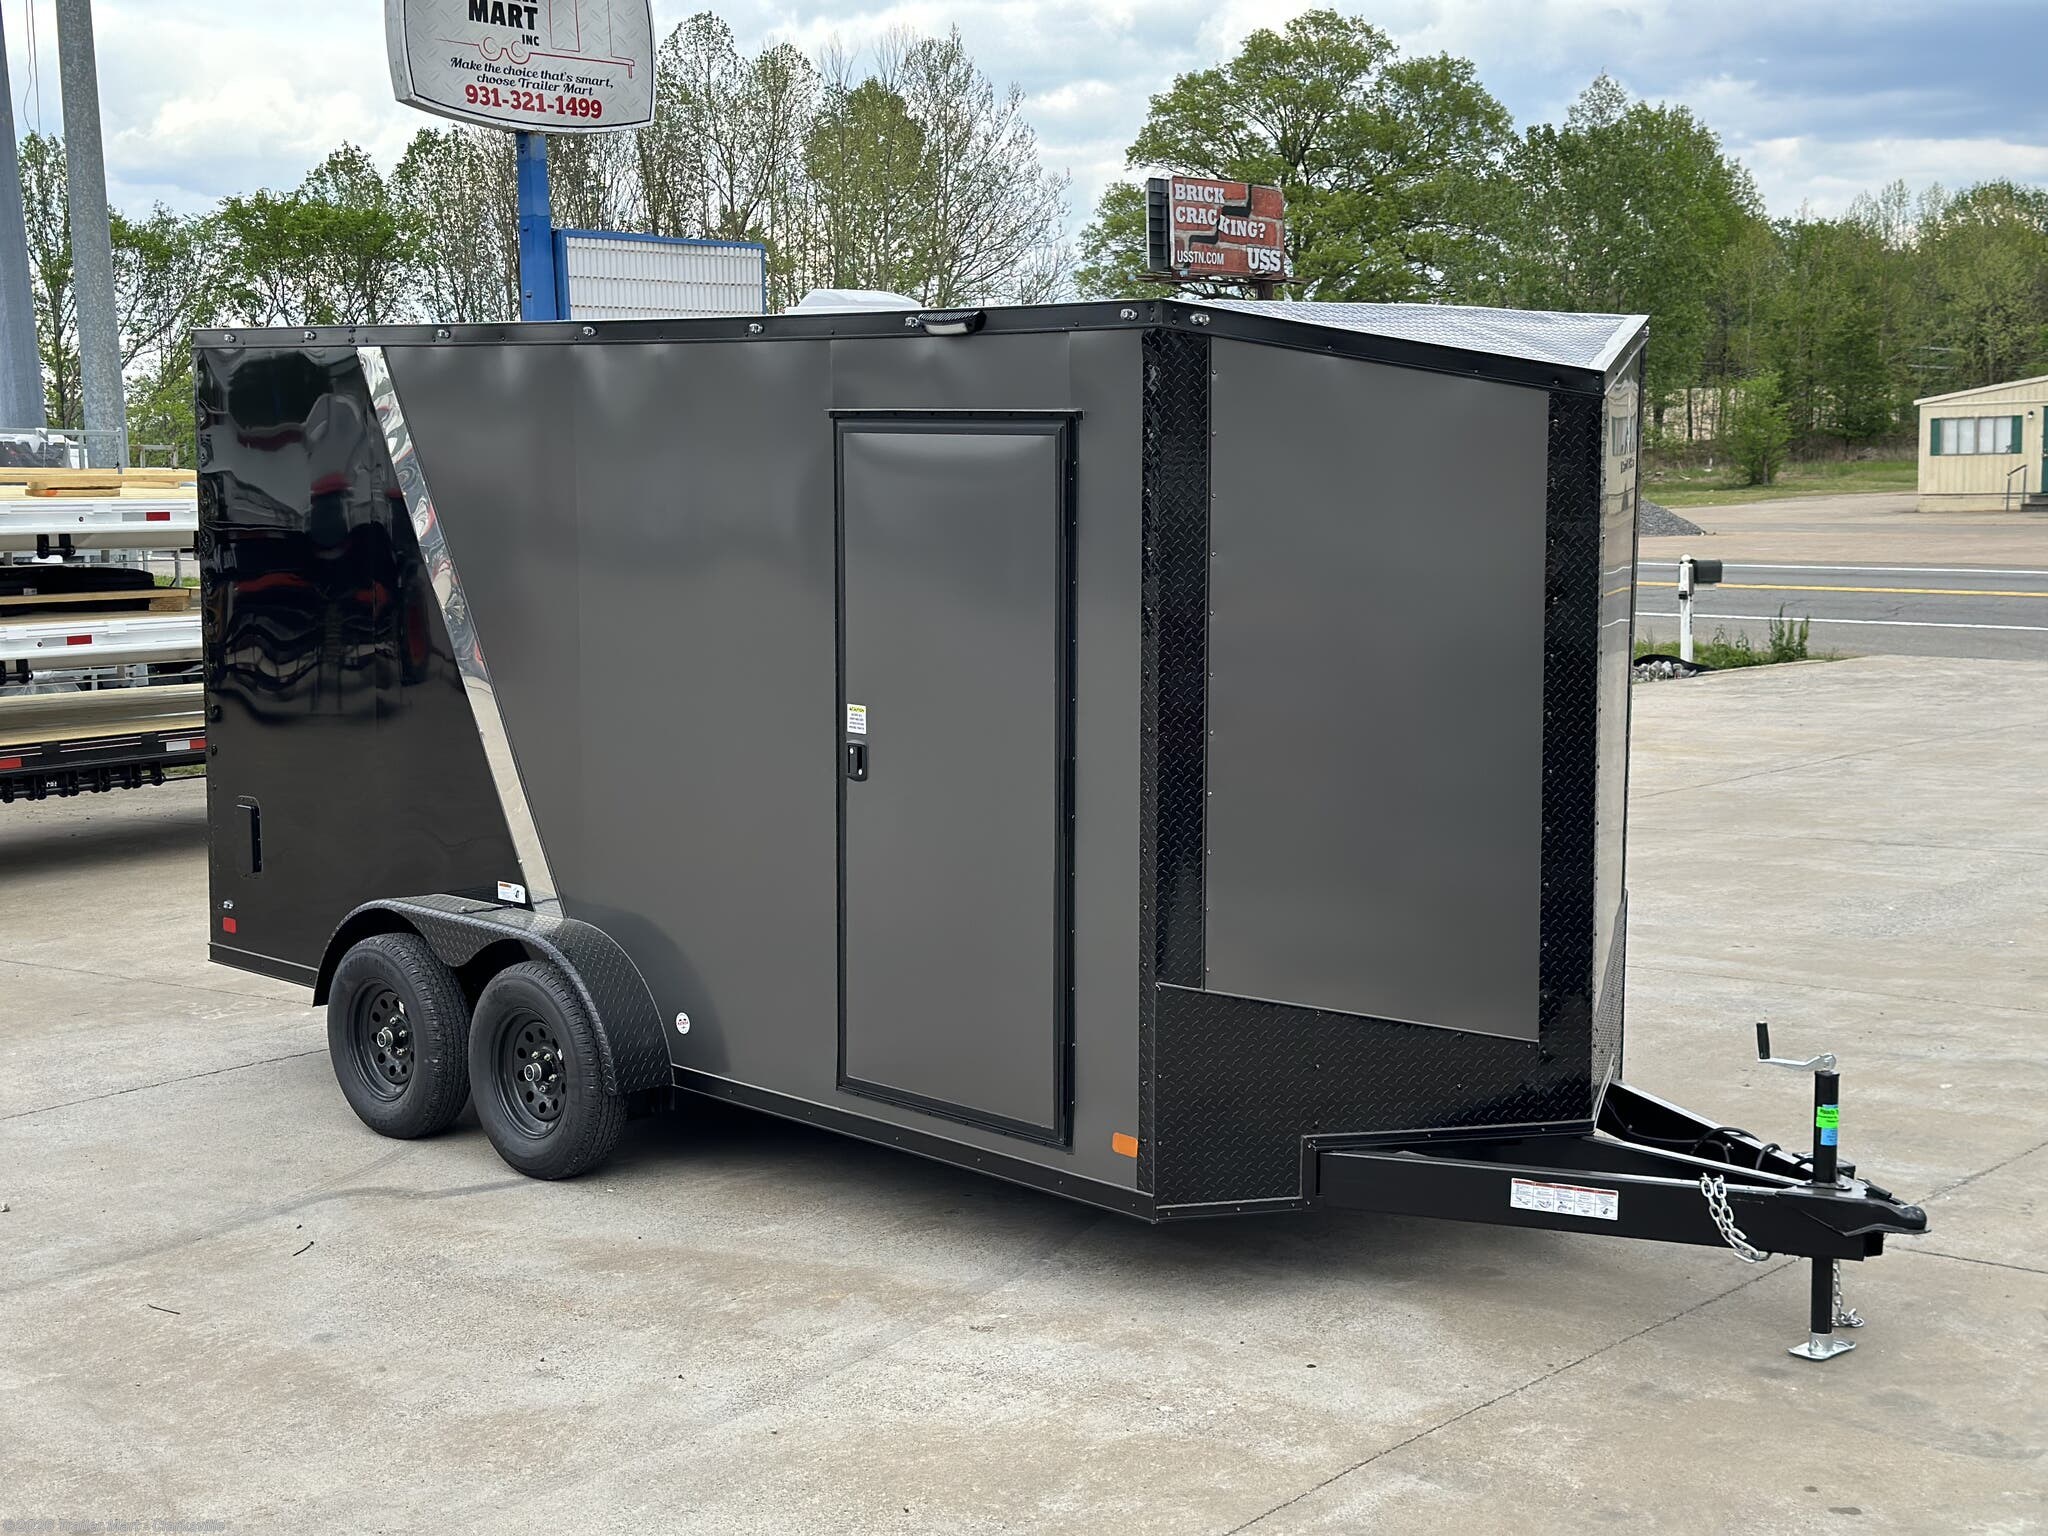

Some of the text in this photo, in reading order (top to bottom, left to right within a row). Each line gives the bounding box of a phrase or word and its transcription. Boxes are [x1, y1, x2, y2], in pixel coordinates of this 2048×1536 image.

[468, 0, 538, 30] MART
[521, 34, 540, 47] INC
[450, 57, 614, 89] Make the choice that's smart,
[476, 73, 594, 97] choose Trailer Mart
[465, 84, 603, 119] 931-321-1499
[1174, 183, 1225, 204] BRICK
[1177, 250, 1224, 265] USSTN.COM
[1246, 247, 1282, 272] USS
